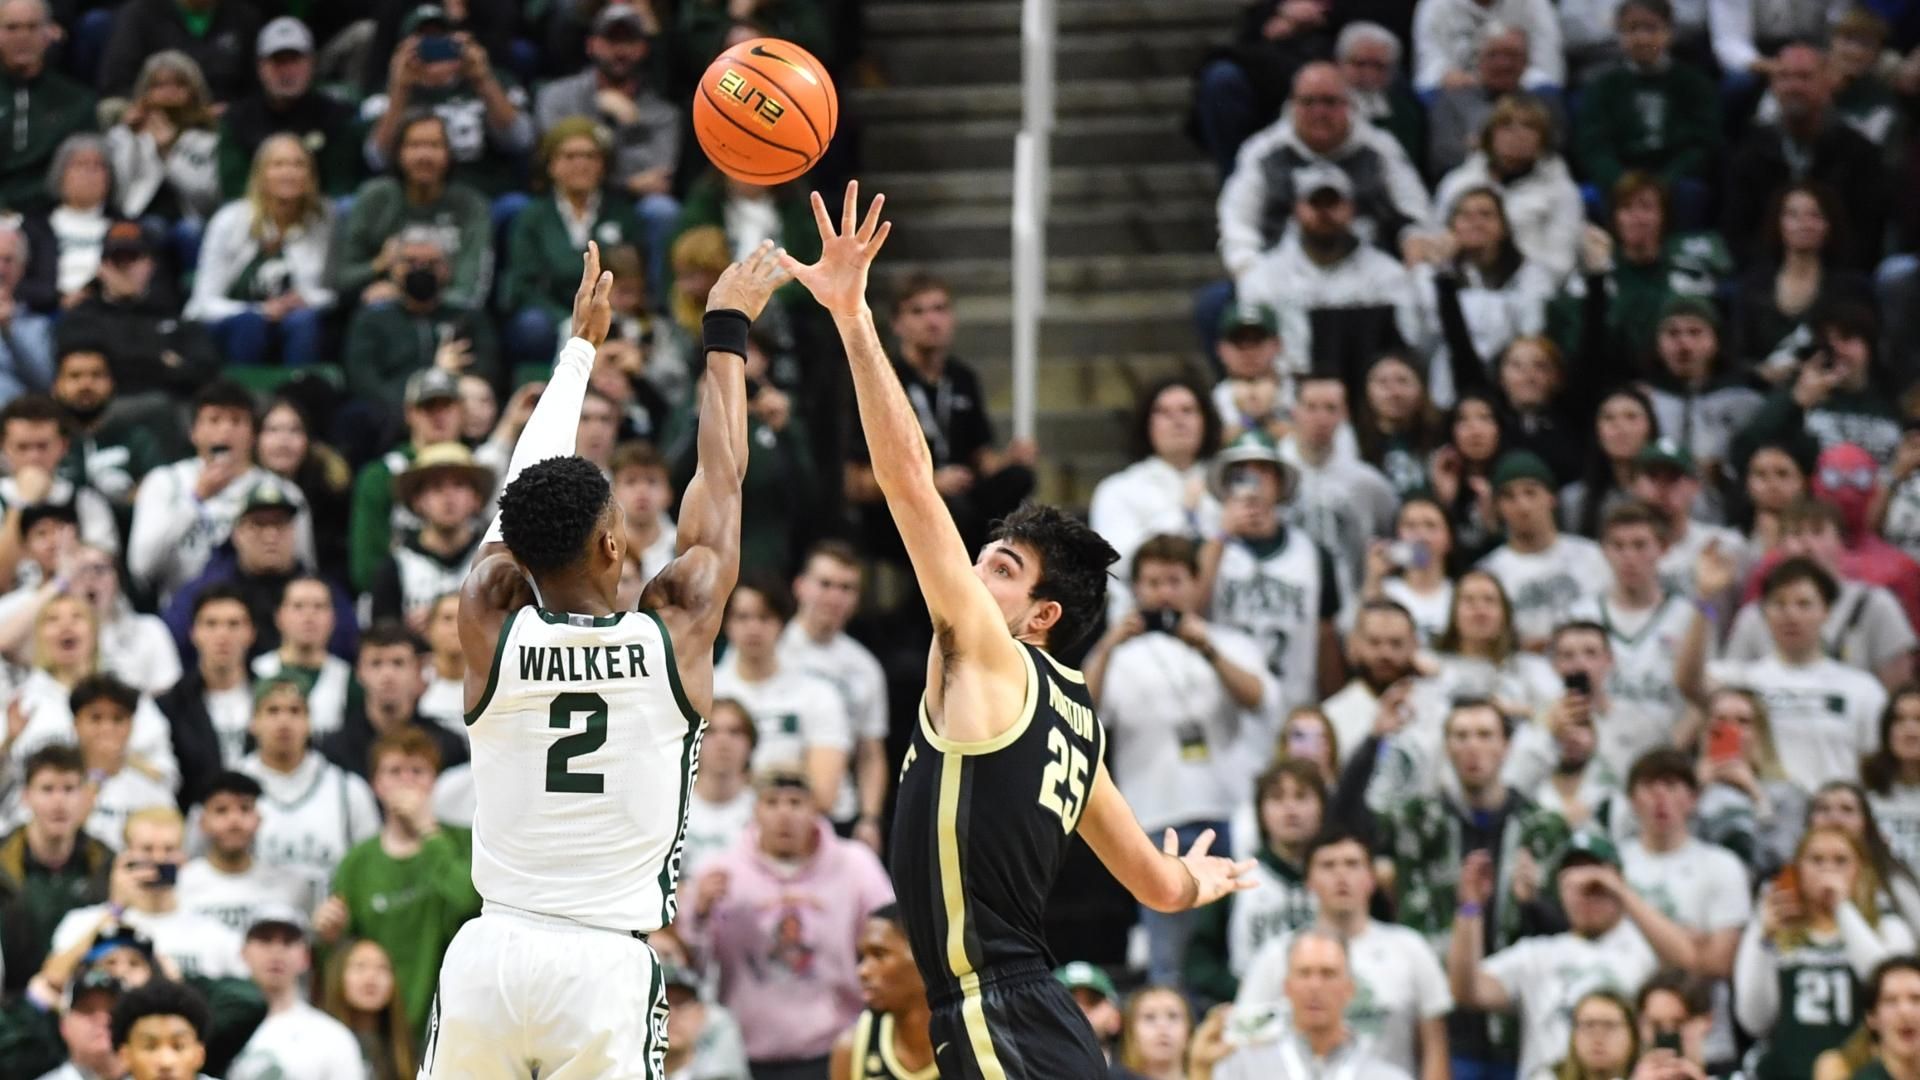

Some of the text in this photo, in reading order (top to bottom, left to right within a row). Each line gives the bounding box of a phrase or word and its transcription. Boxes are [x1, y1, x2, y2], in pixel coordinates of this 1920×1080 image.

[718, 71, 785, 125] ELITE
[518, 643, 650, 681] WALKER
[545, 691, 609, 794] 2
[1038, 725, 1090, 836] 25
[1793, 968, 1853, 1026] 21
